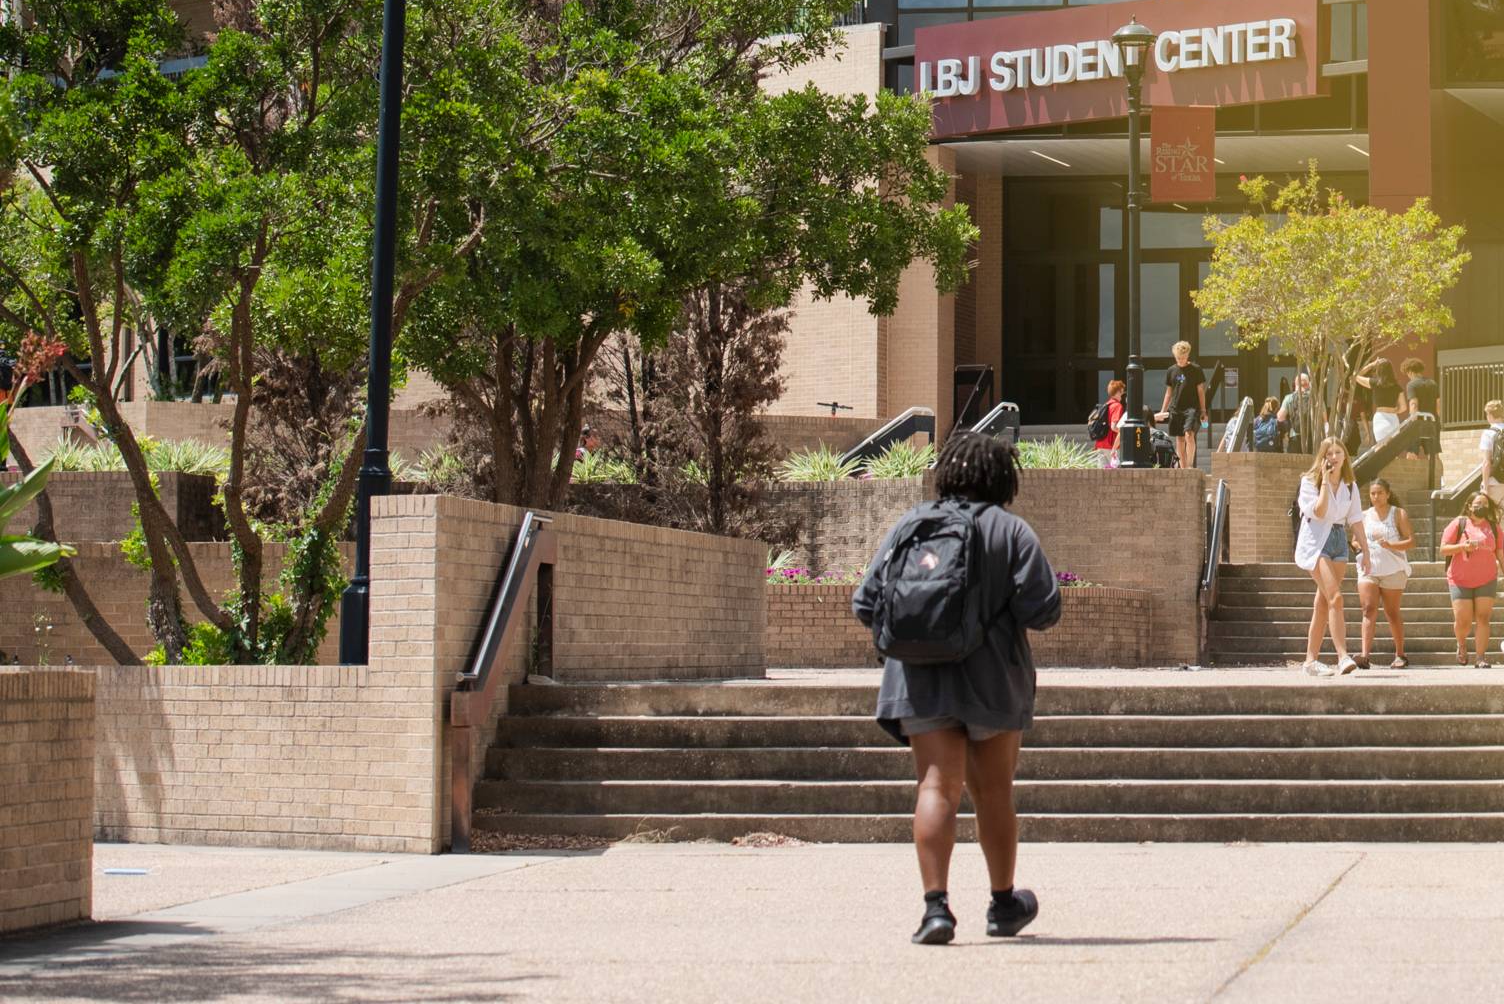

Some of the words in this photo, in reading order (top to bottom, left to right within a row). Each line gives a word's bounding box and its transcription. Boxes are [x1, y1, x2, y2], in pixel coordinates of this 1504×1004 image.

[919, 56, 980, 97] LBJ
[1154, 18, 1296, 73] CENTER
[1155, 155, 1209, 173] STAR
